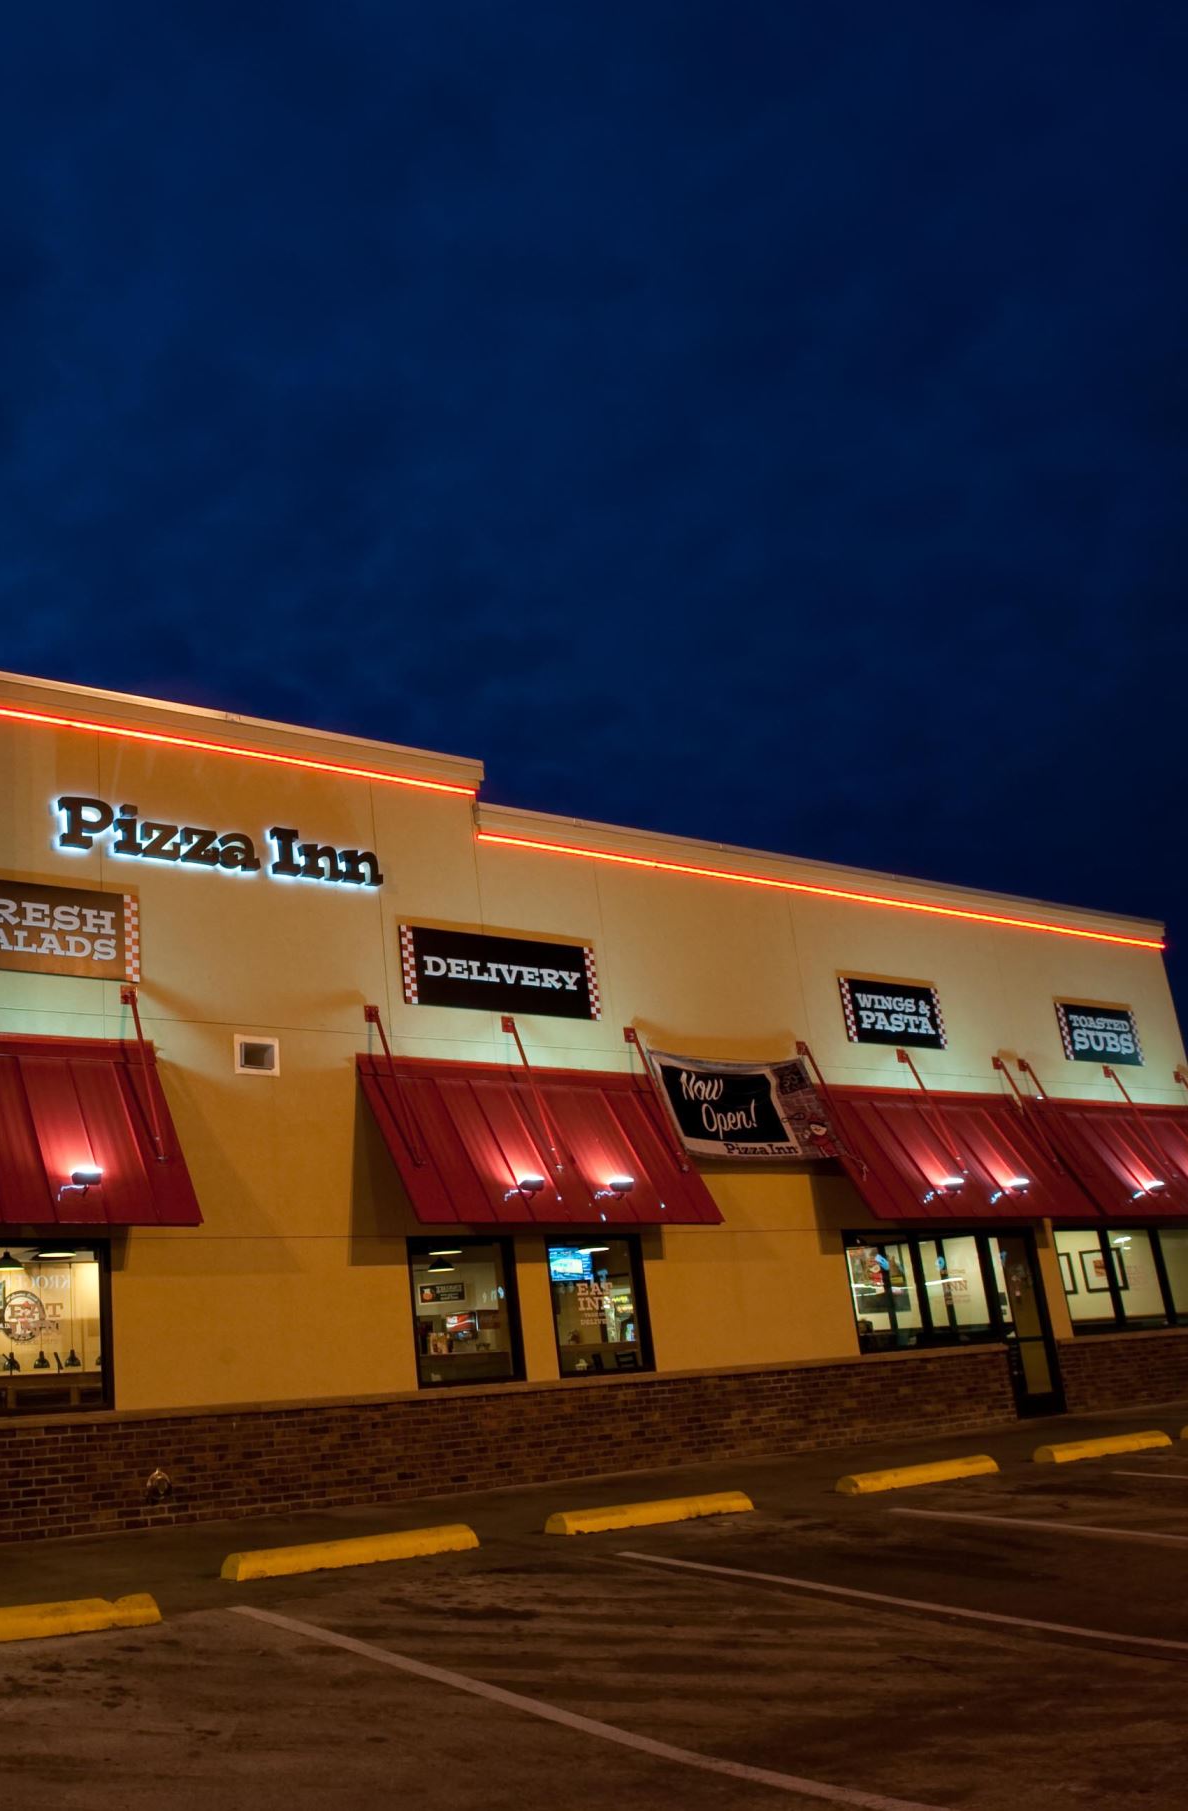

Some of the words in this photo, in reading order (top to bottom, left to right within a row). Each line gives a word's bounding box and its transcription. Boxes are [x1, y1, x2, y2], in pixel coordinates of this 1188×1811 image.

[56, 796, 261, 873] Pizza
[268, 826, 384, 887] Inn
[423, 955, 581, 991] DELIVERY
[855, 993, 917, 1014] WINGS
[918, 1000, 931, 1015] &
[859, 1010, 936, 1035] PASTA
[1069, 1014, 1130, 1033] TOASTED
[1073, 1028, 1136, 1056] SUBS
[680, 1071, 724, 1101] Now
[701, 1099, 758, 1139] Open!
[724, 1142, 769, 1155] Pizza
[767, 1143, 799, 1155] Inn
